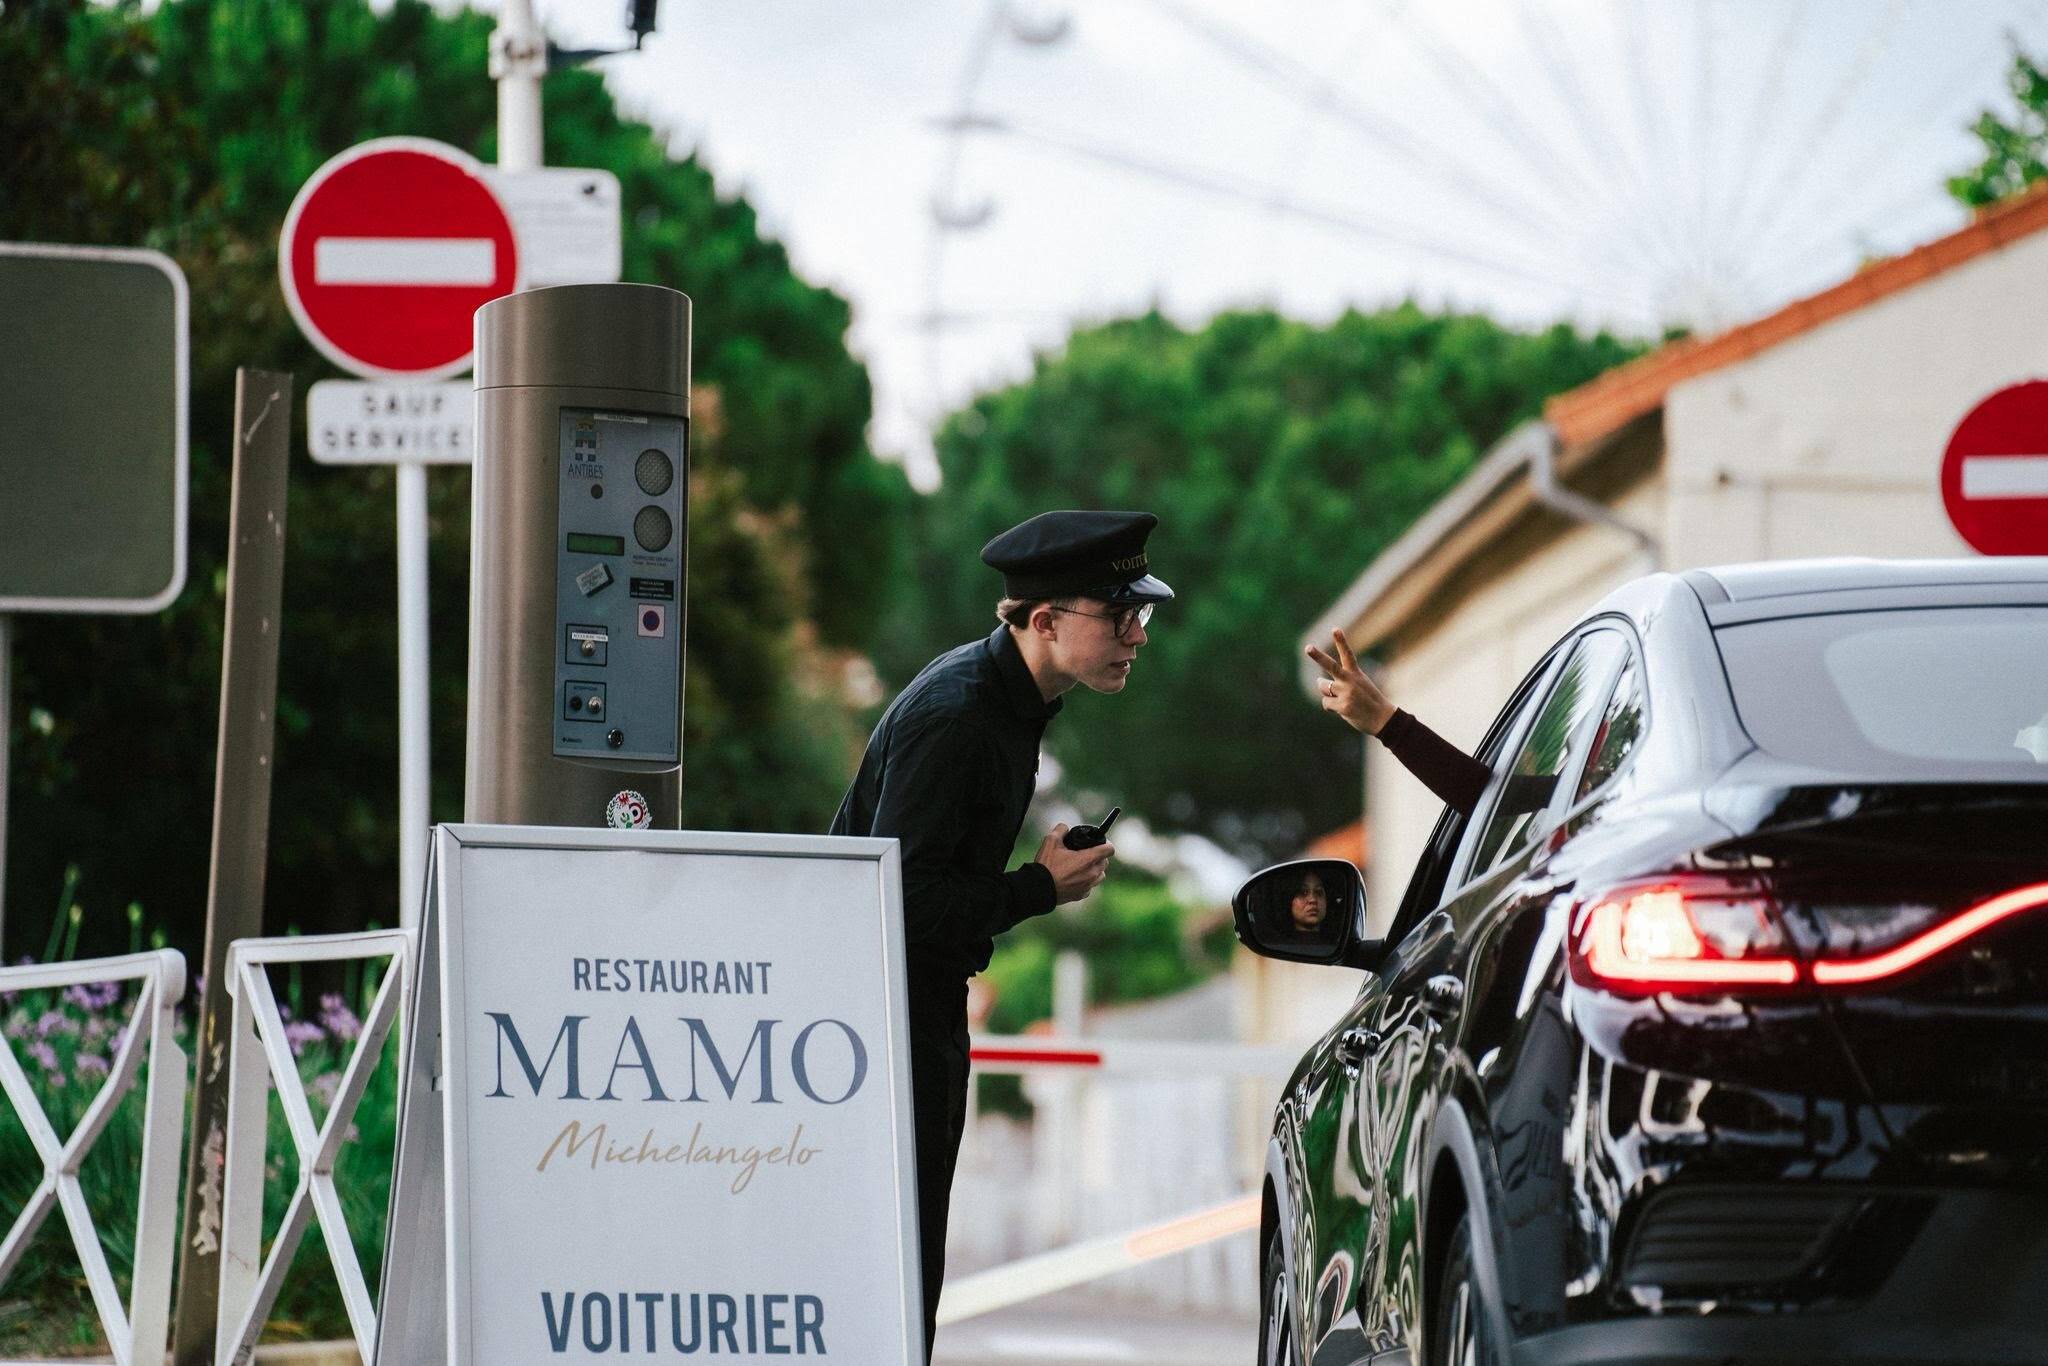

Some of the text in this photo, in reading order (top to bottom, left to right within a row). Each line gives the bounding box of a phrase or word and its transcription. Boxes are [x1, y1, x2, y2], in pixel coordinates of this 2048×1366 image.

[568, 463, 604, 479] ANTIBES
[573, 957, 773, 995] RESTAURANT
[484, 1011, 869, 1105] MAMO
[536, 1119, 823, 1195] Michelangelo
[541, 1291, 828, 1356] VOITURIER
